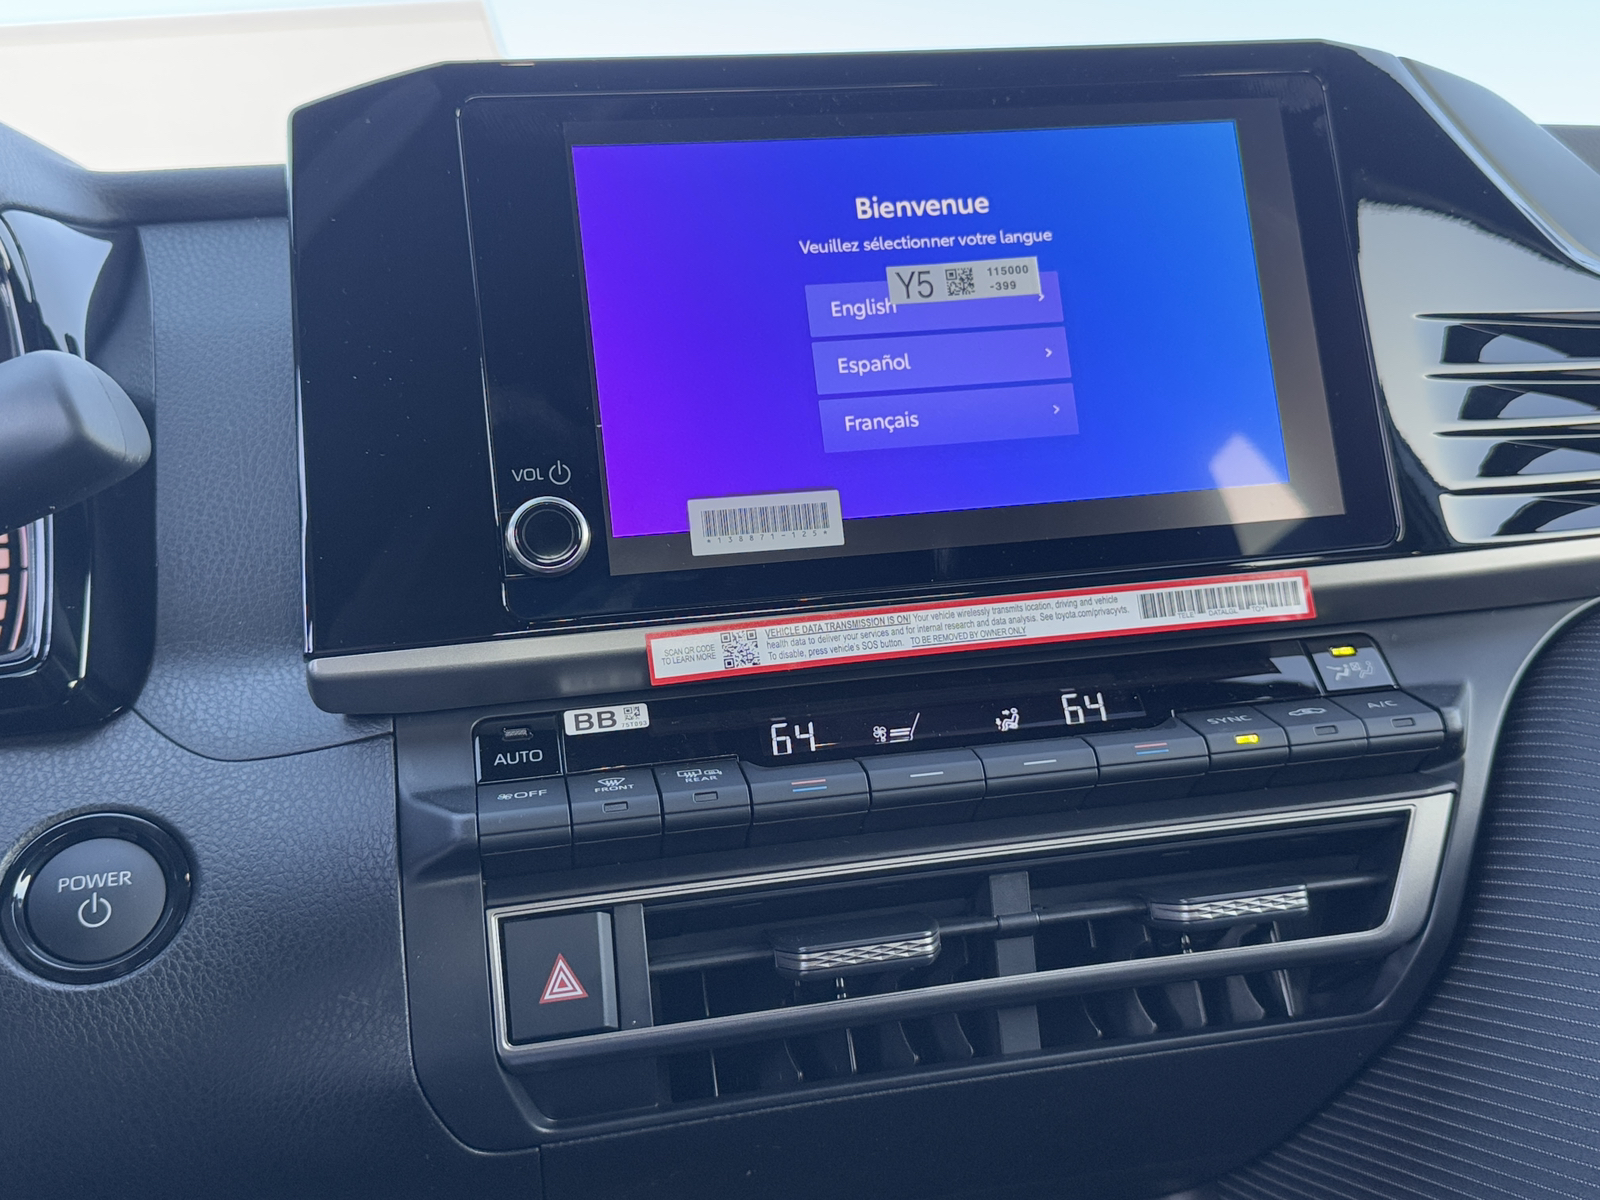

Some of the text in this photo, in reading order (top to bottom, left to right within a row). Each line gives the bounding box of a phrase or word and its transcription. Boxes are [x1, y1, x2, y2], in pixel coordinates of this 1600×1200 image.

[855, 196, 990, 219] Bienvenue
[799, 230, 1053, 254] Veuillez sélectionner votre langue
[987, 264, 1029, 277] 115000
[895, 270, 934, 299] Y5
[990, 280, 1017, 291] -399
[830, 298, 897, 320] English
[837, 353, 911, 376] Español
[844, 411, 919, 433] Français
[511, 467, 545, 482] VOL
[765, 625, 800, 638] VEHICLE
[802, 623, 824, 634] DATA
[824, 618, 885, 631] TRANSMISSION
[897, 614, 911, 624] ON!
[913, 613, 929, 623] Your
[931, 610, 955, 620] vehicle
[957, 607, 990, 618] wirelessly
[992, 604, 1023, 614] transmits
[1025, 601, 1053, 611] location,
[1055, 599, 1078, 609] driving
[1080, 597, 1092, 605] and
[1094, 595, 1118, 604] vehicle
[1177, 611, 1195, 619] TELE
[766, 639, 789, 649] health
[791, 637, 806, 647] data
[808, 636, 816, 645] to
[818, 633, 842, 643] deliver
[843, 632, 858, 643] your
[860, 629, 889, 640] services
[891, 627, 904, 636] and
[906, 625, 915, 634] for
[917, 622, 943, 633] internal
[945, 620, 975, 630] research
[977, 618, 990, 627] and
[992, 616, 1006, 625] data
[1008, 614, 1037, 625] analysis.
[1040, 612, 1054, 621] See
[664, 644, 715, 657] SCAN QR CODE
[768, 626, 1027, 660] To disable, press vehicle's SOS button. TO BE REMOVED BY OWNER ONLY
[661, 652, 717, 666] TO LEARN MORE
[1061, 692, 1107, 725] 64
[1367, 700, 1398, 709] A/C
[574, 710, 617, 731] BB
[1206, 714, 1252, 726] SYNC
[770, 721, 816, 756] 64
[493, 749, 543, 766] AUTO
[594, 783, 634, 793] FRONT
[685, 775, 718, 783] REAR
[514, 789, 548, 799] OFF
[58, 870, 133, 893] POWER
